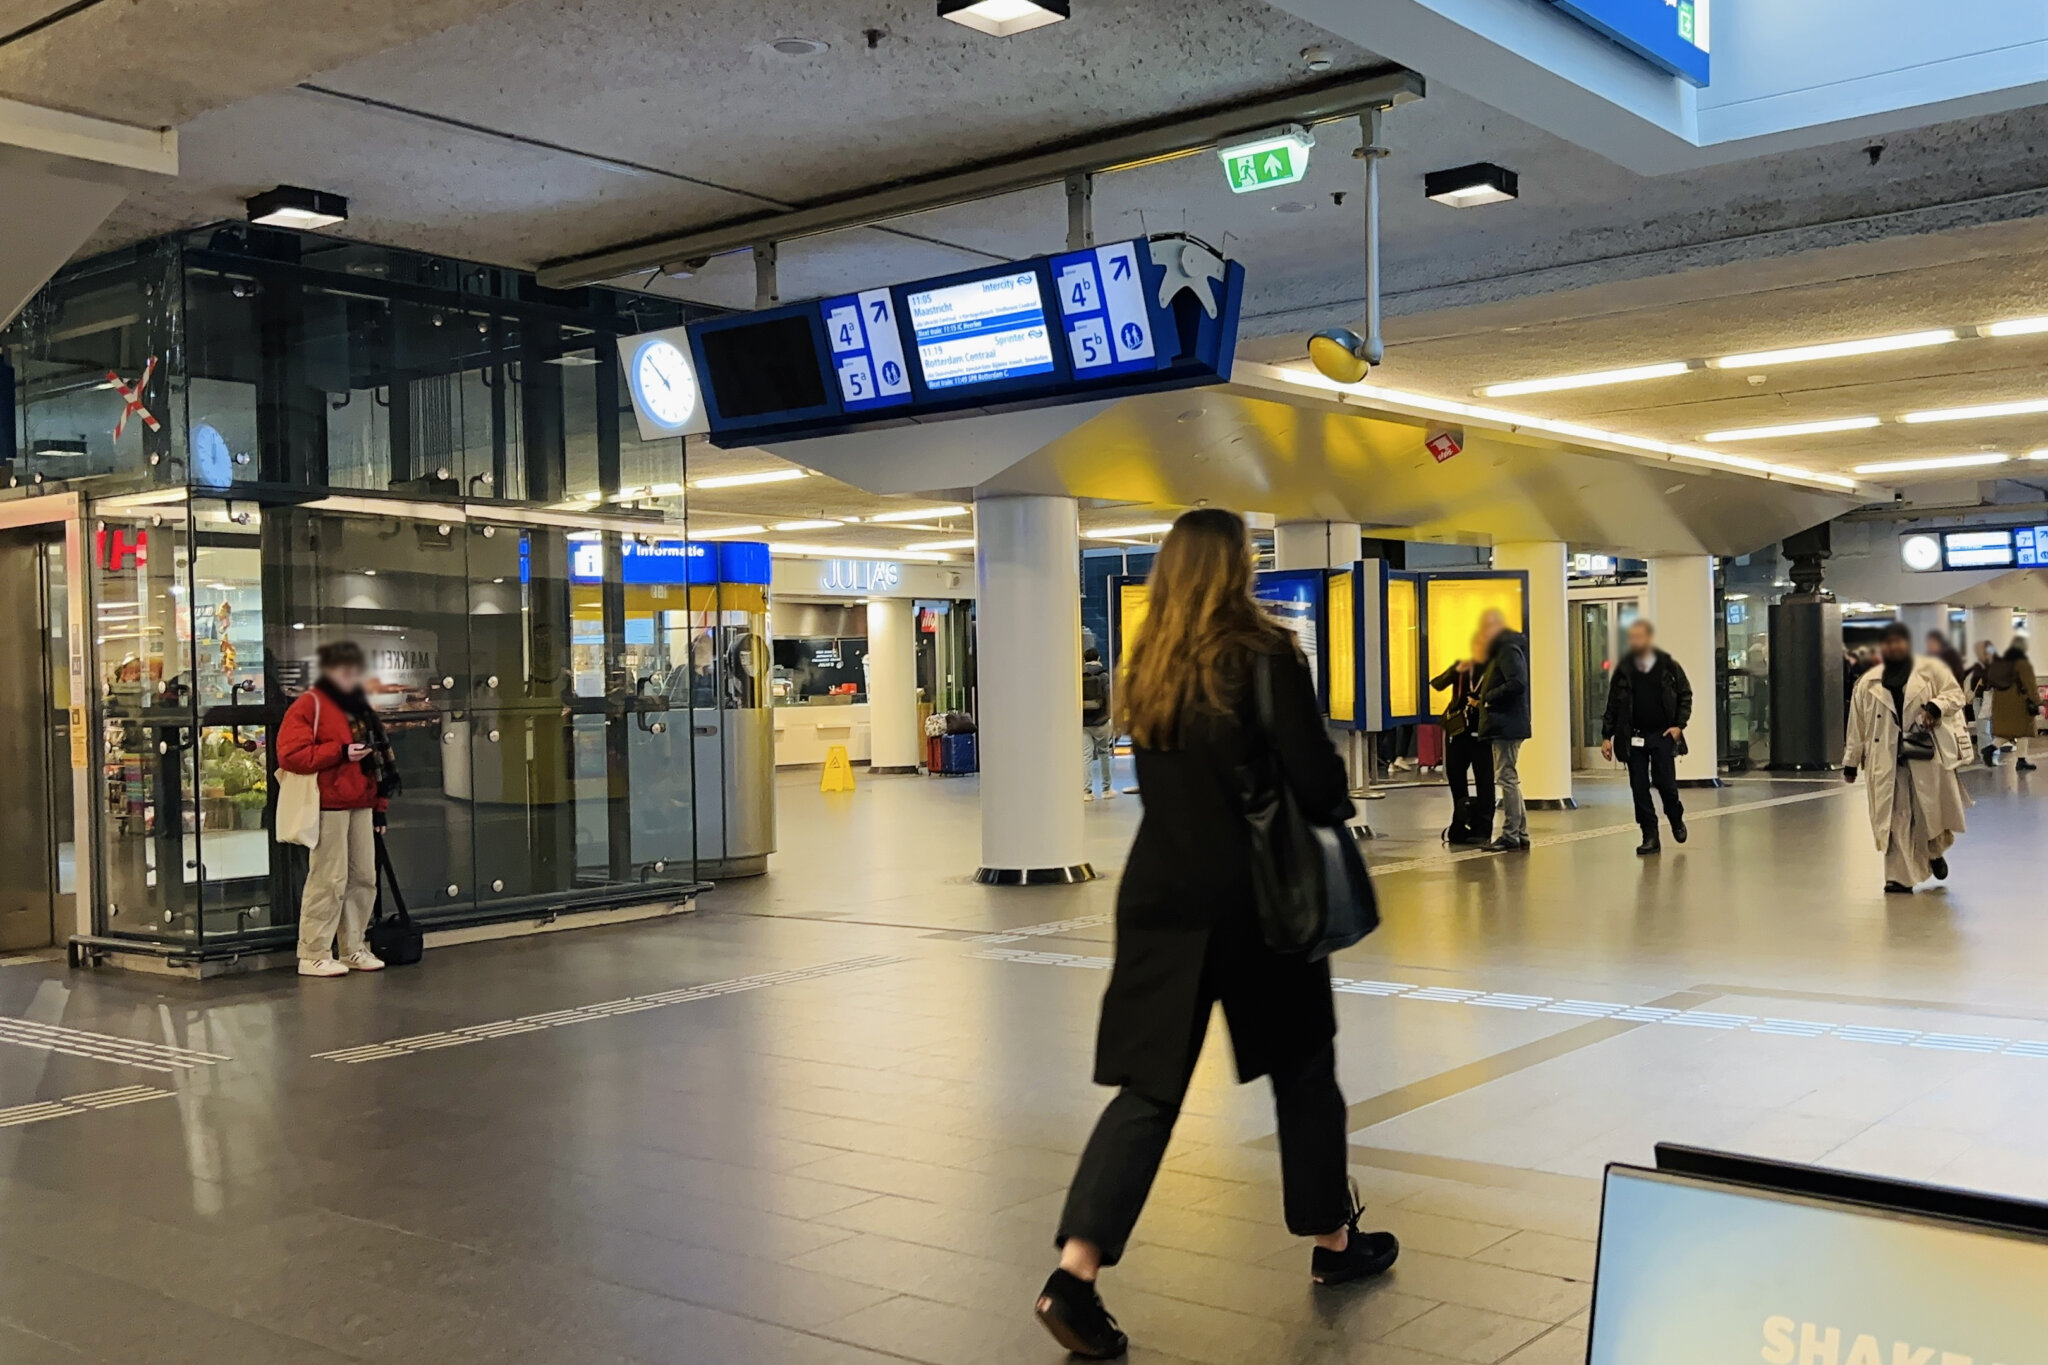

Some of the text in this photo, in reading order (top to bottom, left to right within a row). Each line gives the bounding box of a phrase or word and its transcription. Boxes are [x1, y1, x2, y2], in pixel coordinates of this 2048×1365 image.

[982, 278, 1014, 294] Intercity
[1072, 277, 1091, 307] 4b
[912, 294, 932, 306] 11:05
[913, 303, 953, 318] Maastricht
[994, 333, 1025, 346] Sprinter
[1082, 333, 1102, 362] 5b
[925, 356, 963, 369] Rotterdam
[965, 350, 997, 361] Centraal
[978, 371, 1003, 381] Rotterdam
[636, 544, 706, 558] Informatie
